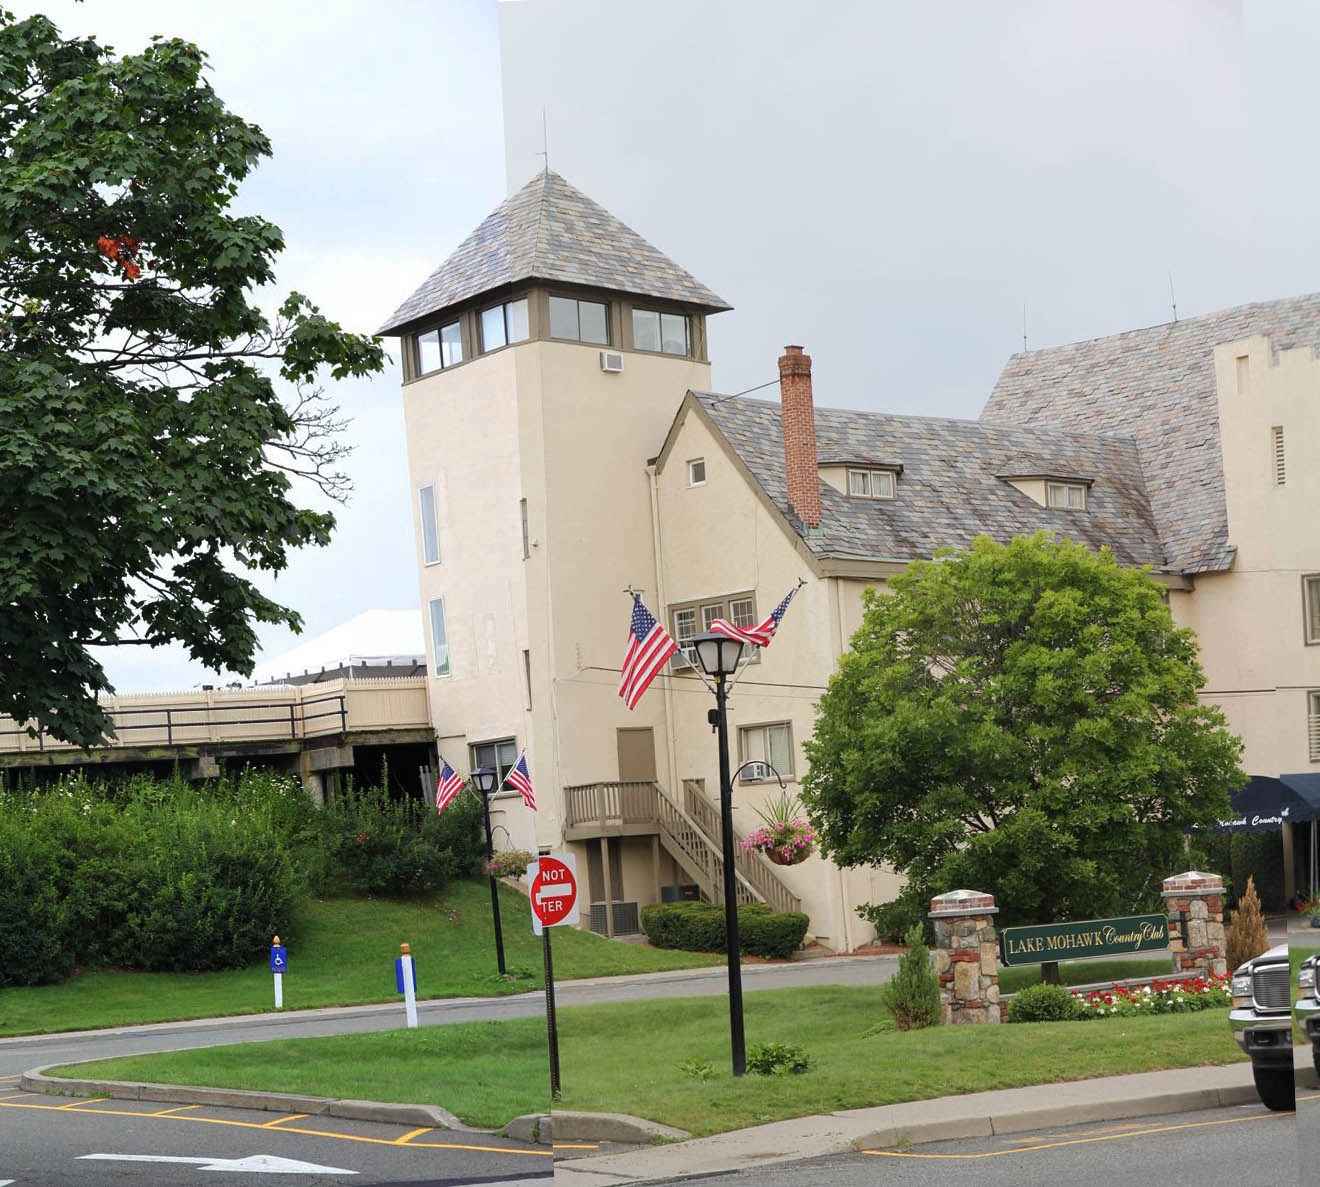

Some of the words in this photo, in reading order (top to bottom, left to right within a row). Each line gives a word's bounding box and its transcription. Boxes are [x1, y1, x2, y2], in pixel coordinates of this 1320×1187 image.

[1251, 815, 1283, 826] Country
[542, 868, 566, 881] NOT
[1009, 937, 1044, 954] LAKE
[1047, 931, 1104, 951] MOHAWK
[1103, 925, 1144, 950] Country
[1140, 921, 1164, 941] Club
